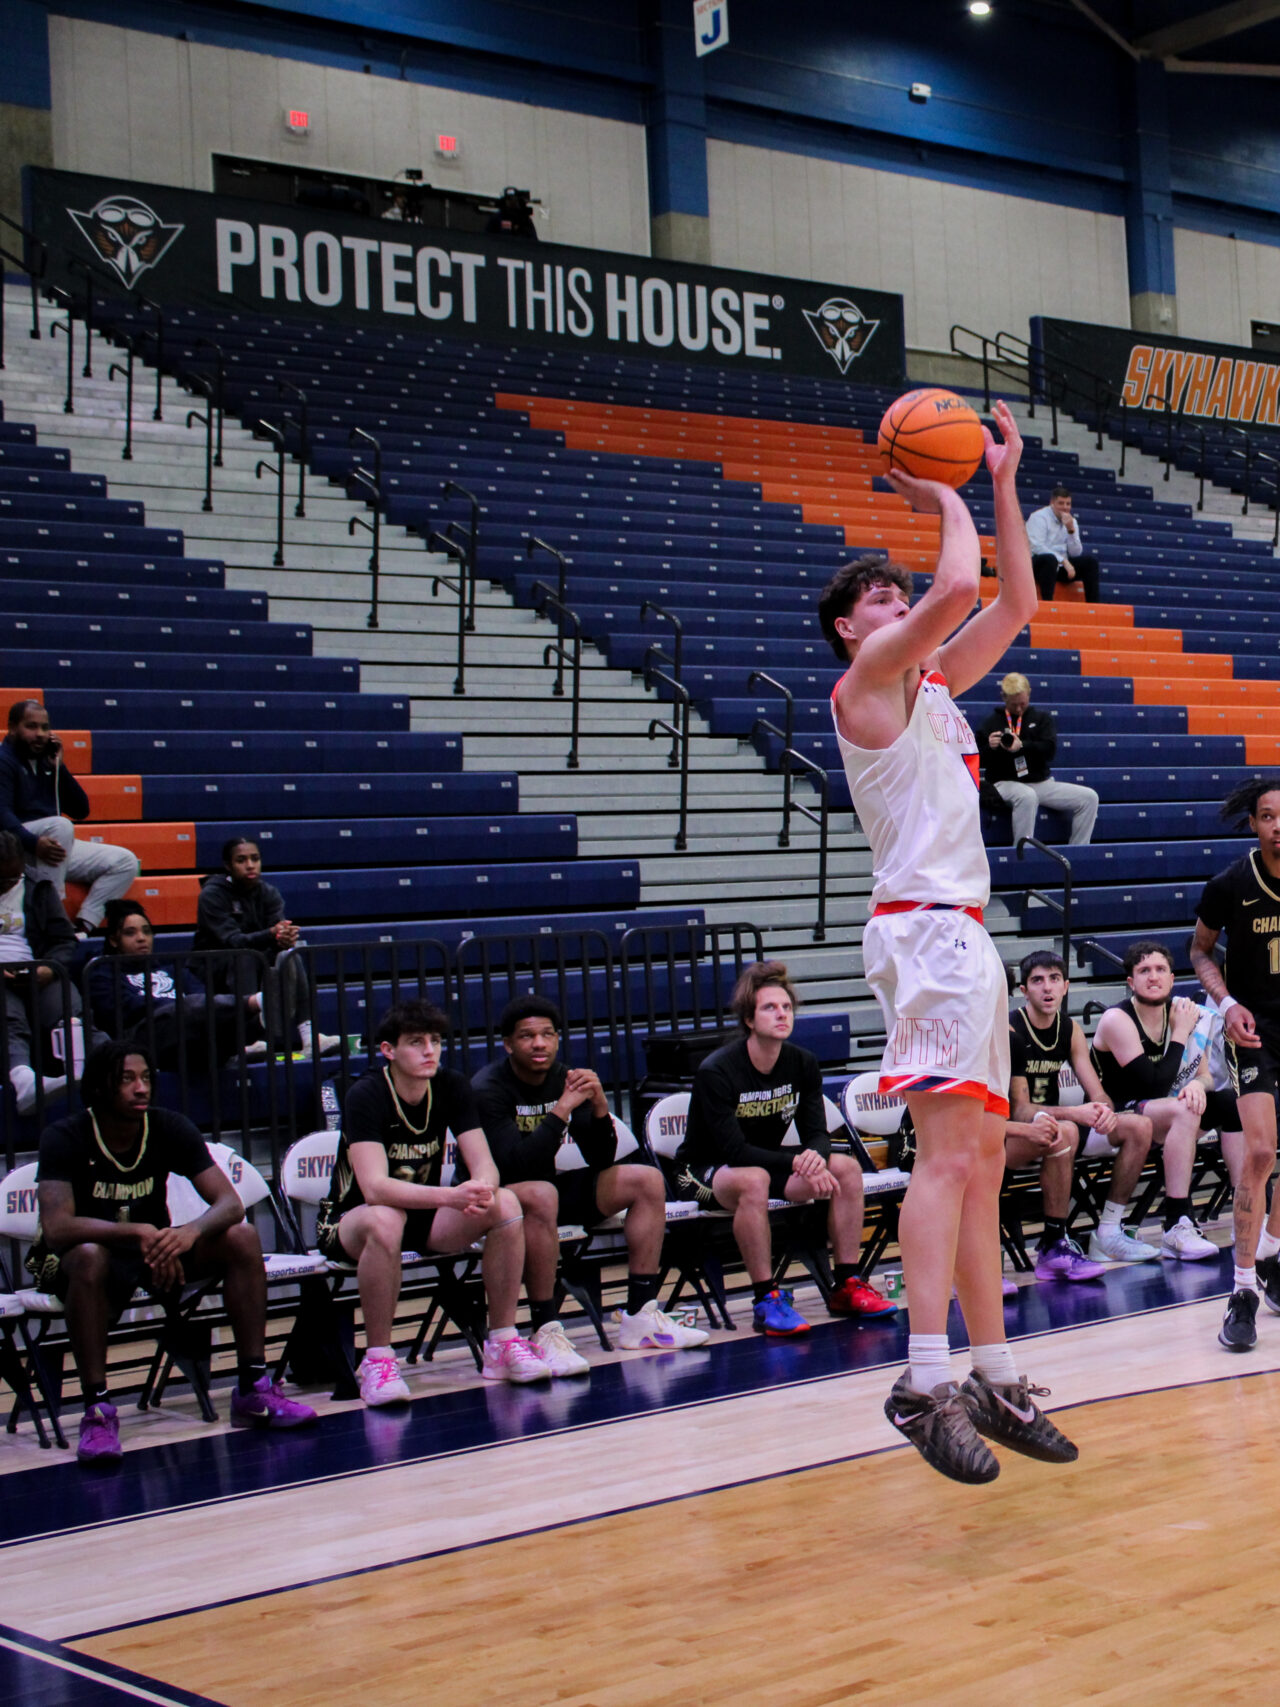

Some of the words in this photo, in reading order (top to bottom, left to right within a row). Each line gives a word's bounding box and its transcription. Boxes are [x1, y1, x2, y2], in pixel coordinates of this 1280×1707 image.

[701, 8, 721, 46] J
[216, 217, 486, 323] PROTECT
[497, 257, 595, 338] THIS
[894, 1017, 959, 1068] UTM
[855, 1094, 906, 1112] SKYHAW
[659, 1115, 688, 1135] SKYH
[298, 1155, 334, 1178] SKYH
